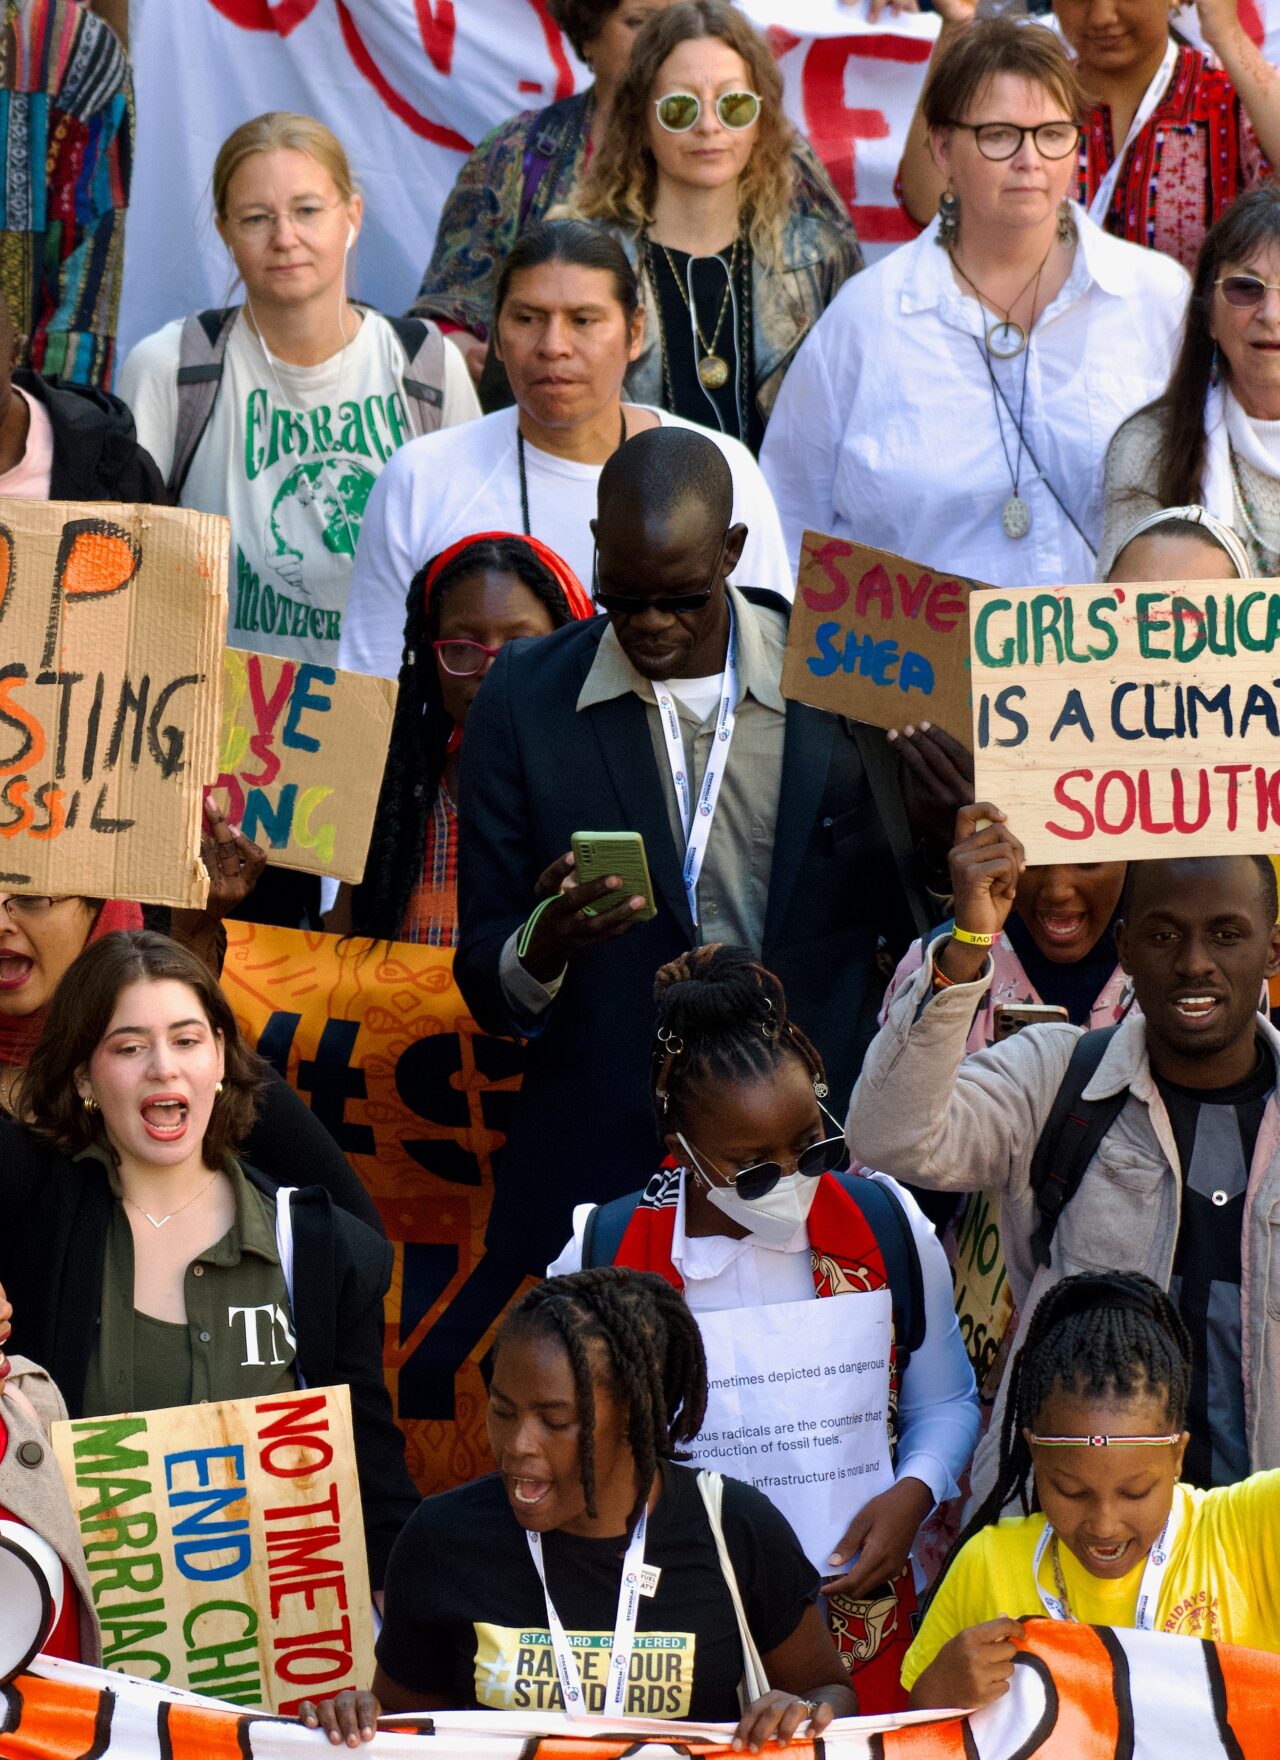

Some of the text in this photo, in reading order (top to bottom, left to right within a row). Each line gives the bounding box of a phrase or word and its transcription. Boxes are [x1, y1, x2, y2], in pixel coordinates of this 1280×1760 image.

[802, 540, 967, 633] SAVE
[806, 621, 935, 695] SHEA
[975, 588, 1126, 668] GIRLS'
[978, 678, 1280, 749] IS A CLIMA
[706, 1358, 885, 1390] ometimes depicted as dangerous
[255, 1395, 334, 1478] NO
[691, 1443, 758, 1461] production
[761, 1441, 773, 1453] of
[777, 1436, 810, 1451] fossil
[813, 1434, 842, 1447] fuels.
[693, 1410, 882, 1442] ous radicals are the countries that
[752, 1471, 836, 1488] infrastructure
[838, 1467, 846, 1479] is
[847, 1463, 864, 1477] moral
[865, 1460, 880, 1473] and
[164, 1444, 252, 1582] END
[71, 1417, 171, 1683] MARRIAG
[263, 1482, 348, 1620] TIME
[640, 1583, 654, 1592] ATY
[273, 1614, 353, 1685] TO
[516, 1648, 682, 1683] RASE OUR
[521, 1633, 591, 1648] STANARD
[514, 1678, 681, 1713] STADRDS
